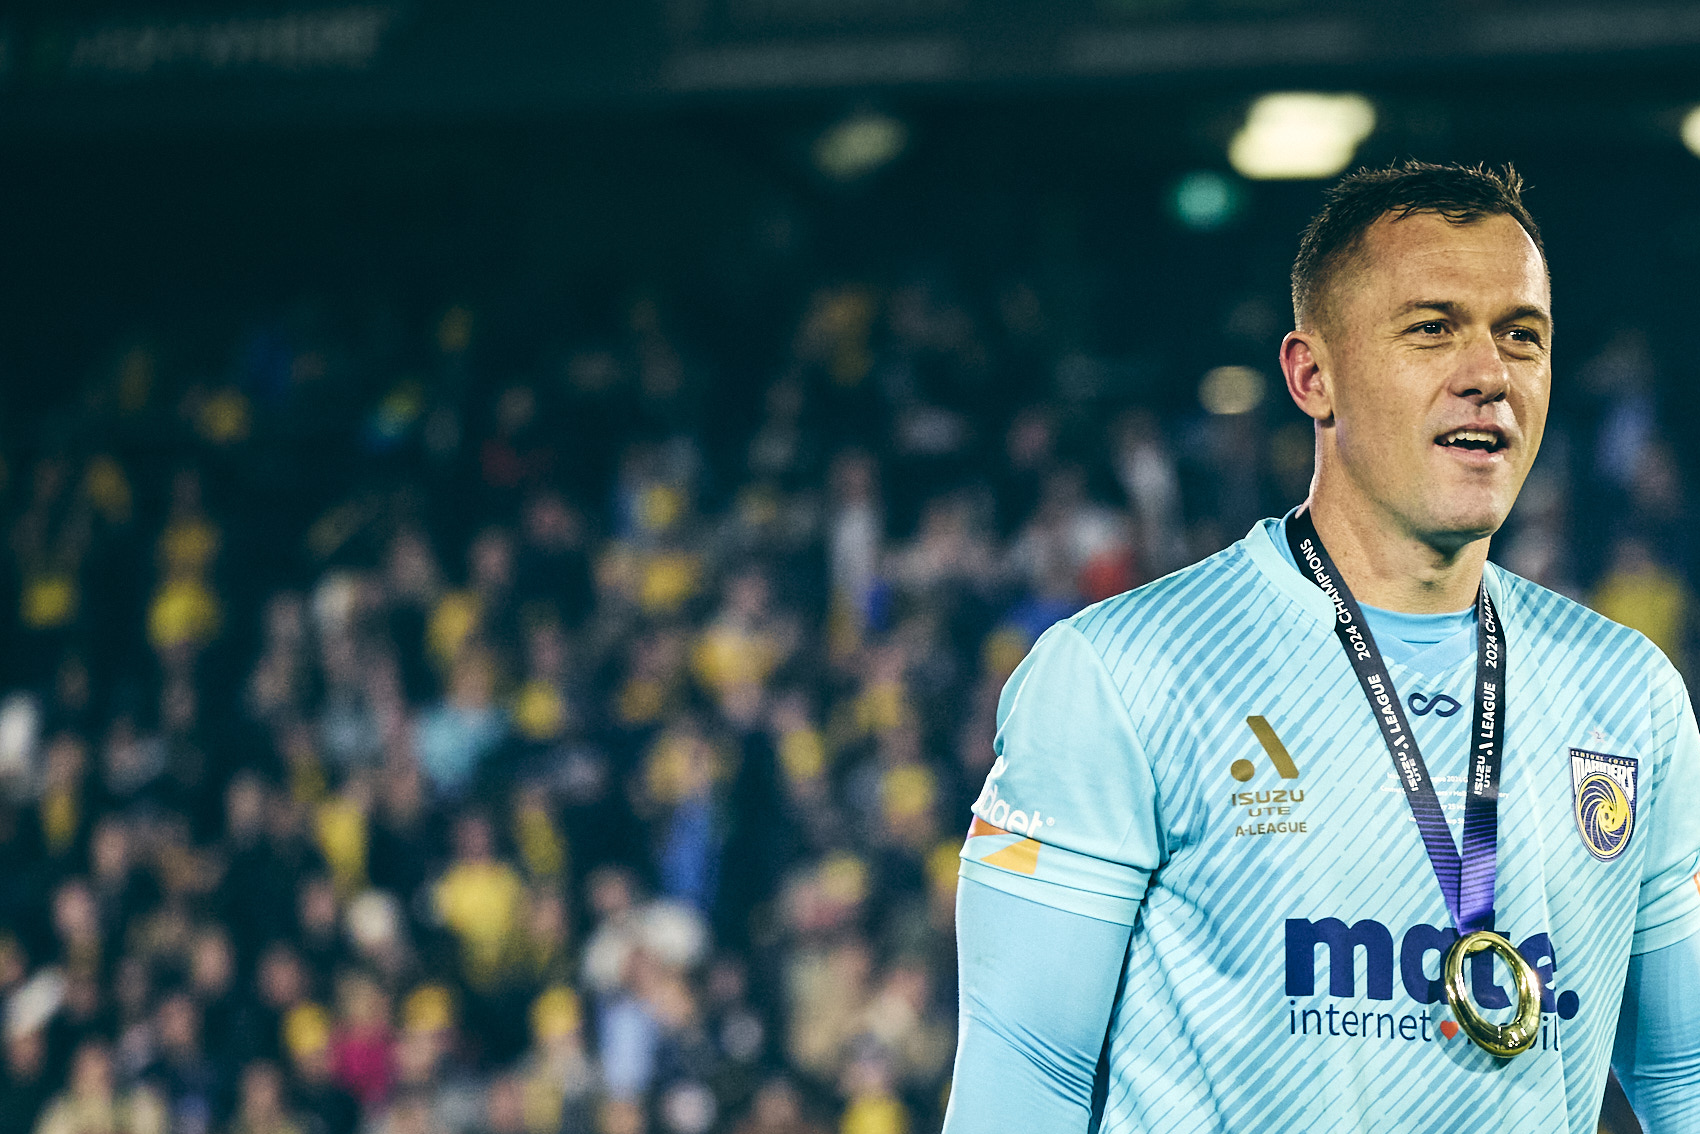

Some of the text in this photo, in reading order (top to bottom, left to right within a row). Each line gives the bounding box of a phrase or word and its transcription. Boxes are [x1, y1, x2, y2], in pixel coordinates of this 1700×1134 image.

[1300, 538, 1352, 624] CHAMPIONS
[1345, 624, 1371, 661] 2024
[1485, 634, 1498, 669] 2024
[1367, 673, 1401, 734] LEAGUE
[1480, 681, 1496, 739] LEAGUE
[1397, 751, 1419, 792] ISUZU
[1474, 755, 1486, 796] ISUZU
[1484, 765, 1492, 788] UTE
[1571, 756, 1636, 802] MARINERS
[1231, 789, 1305, 807] ISUZU
[1248, 806, 1291, 818] UTE
[1235, 821, 1308, 838] A-LEAGUE
[1290, 1000, 1432, 1042] internet
